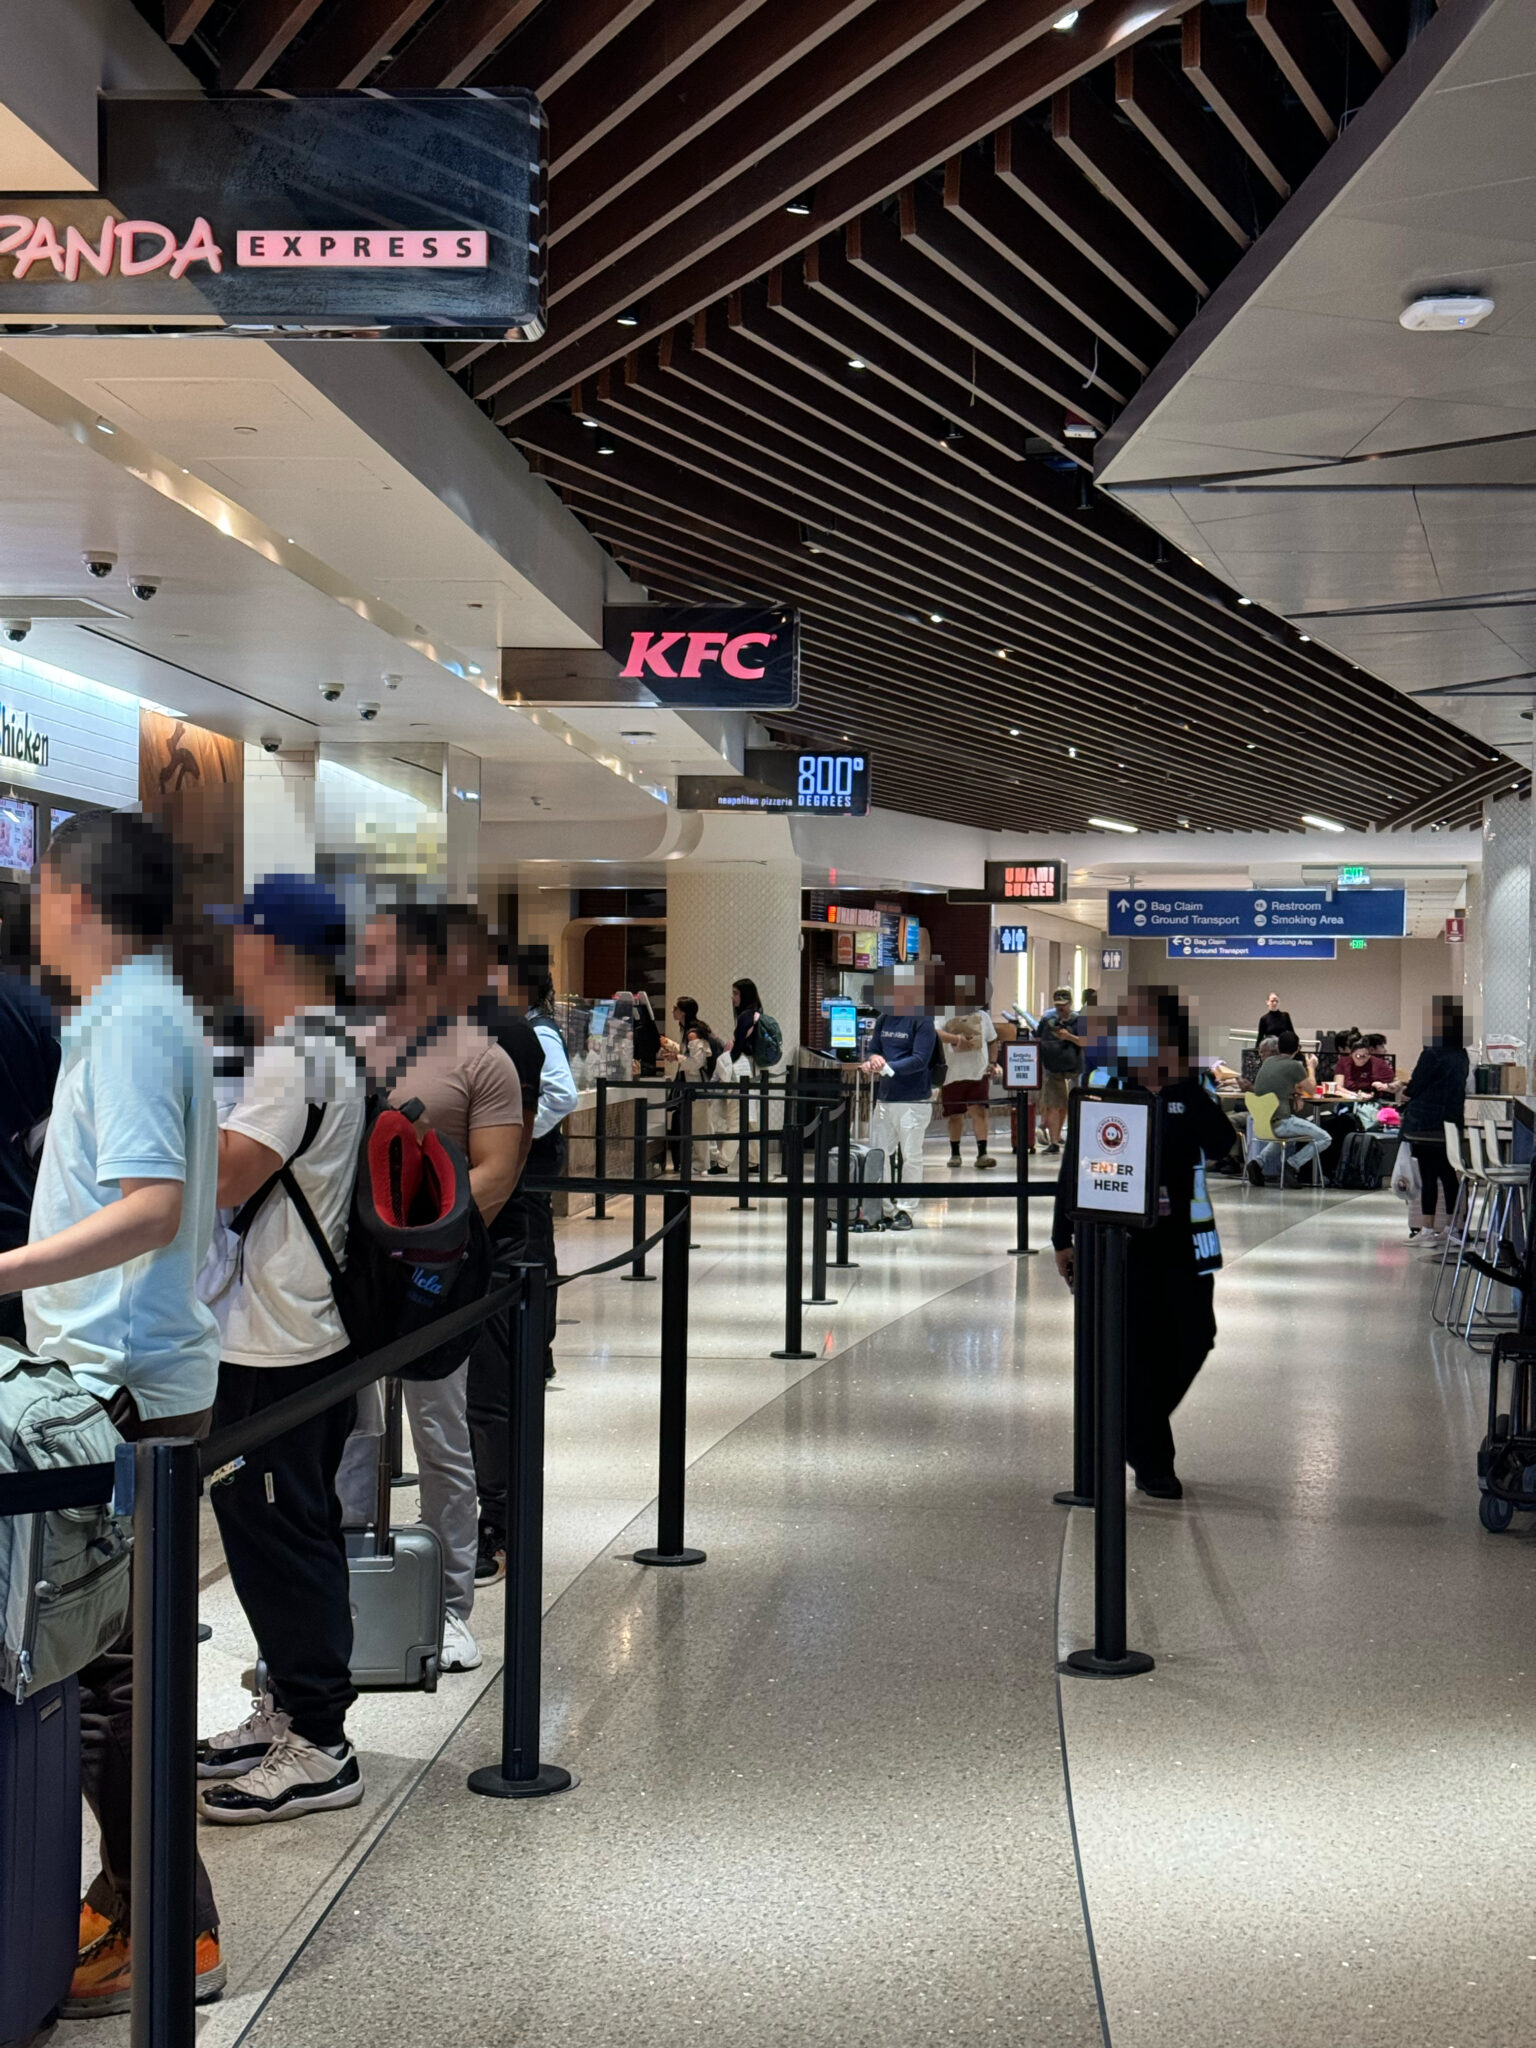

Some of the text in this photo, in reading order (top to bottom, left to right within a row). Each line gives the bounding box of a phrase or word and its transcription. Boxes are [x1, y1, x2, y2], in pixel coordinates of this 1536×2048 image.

[248, 235, 473, 259] EXPRESS
[0, 702, 49, 767] hicken
[717, 795, 793, 807] neapolitan pizzeria
[797, 794, 851, 807] DEGREES
[1004, 866, 1055, 883] UMAMI
[1004, 882, 1054, 897] BURGER
[1150, 901, 1204, 913] Bag Claim
[1271, 901, 1322, 911] Restroom
[1150, 915, 1240, 926] Ground Transport
[1271, 915, 1345, 926] Smoking Area
[1193, 938, 1207, 946] Bag
[1268, 938, 1297, 947] Smoking
[1193, 947, 1249, 956] Ground Transport
[1090, 1162, 1134, 1176] ENTER
[1094, 1179, 1129, 1193] HERE
